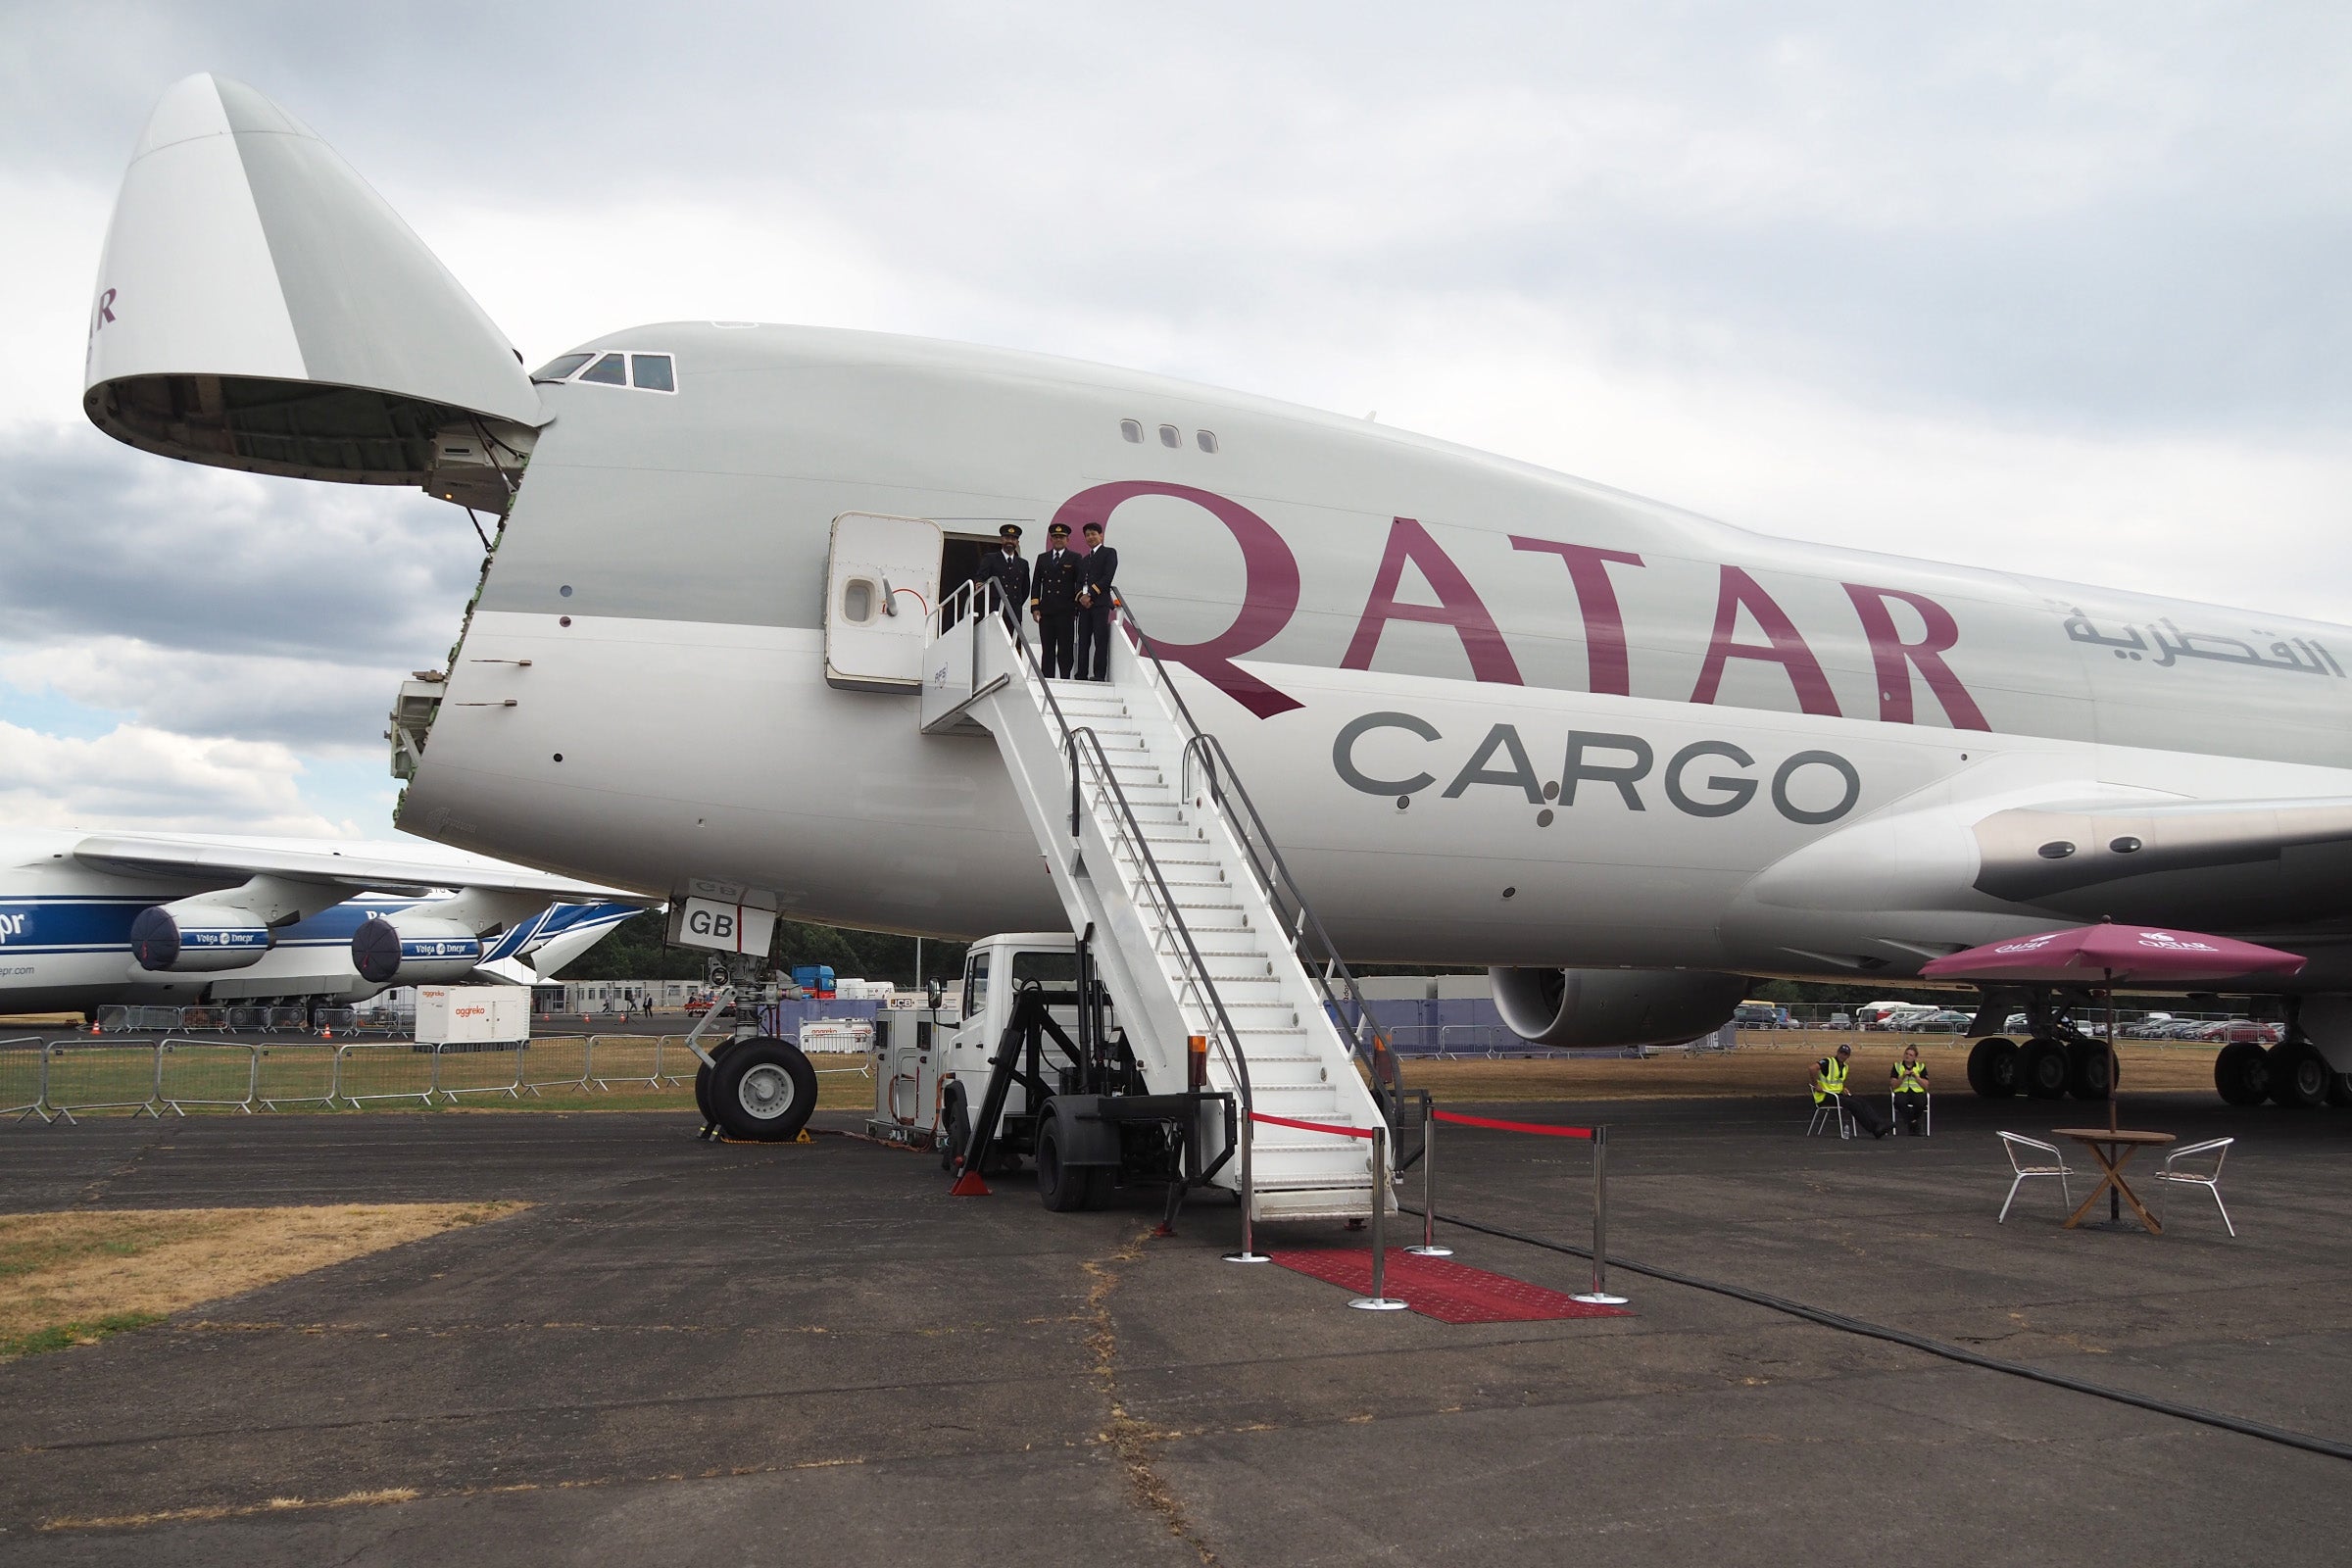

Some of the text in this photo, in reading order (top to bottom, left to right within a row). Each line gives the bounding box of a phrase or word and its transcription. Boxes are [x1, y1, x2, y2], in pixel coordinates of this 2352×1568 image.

[1047, 480, 1992, 733] QATAR
[2043, 599, 2346, 678] القطرية
[1333, 711, 1860, 825] CARGO
[690, 910, 733, 938] GB
[196, 934, 254, 946] Volga Dnepr
[416, 945, 466, 956] Volga Dnepr
[455, 1005, 485, 1017] aggreko
[891, 999, 912, 1007] JCB
